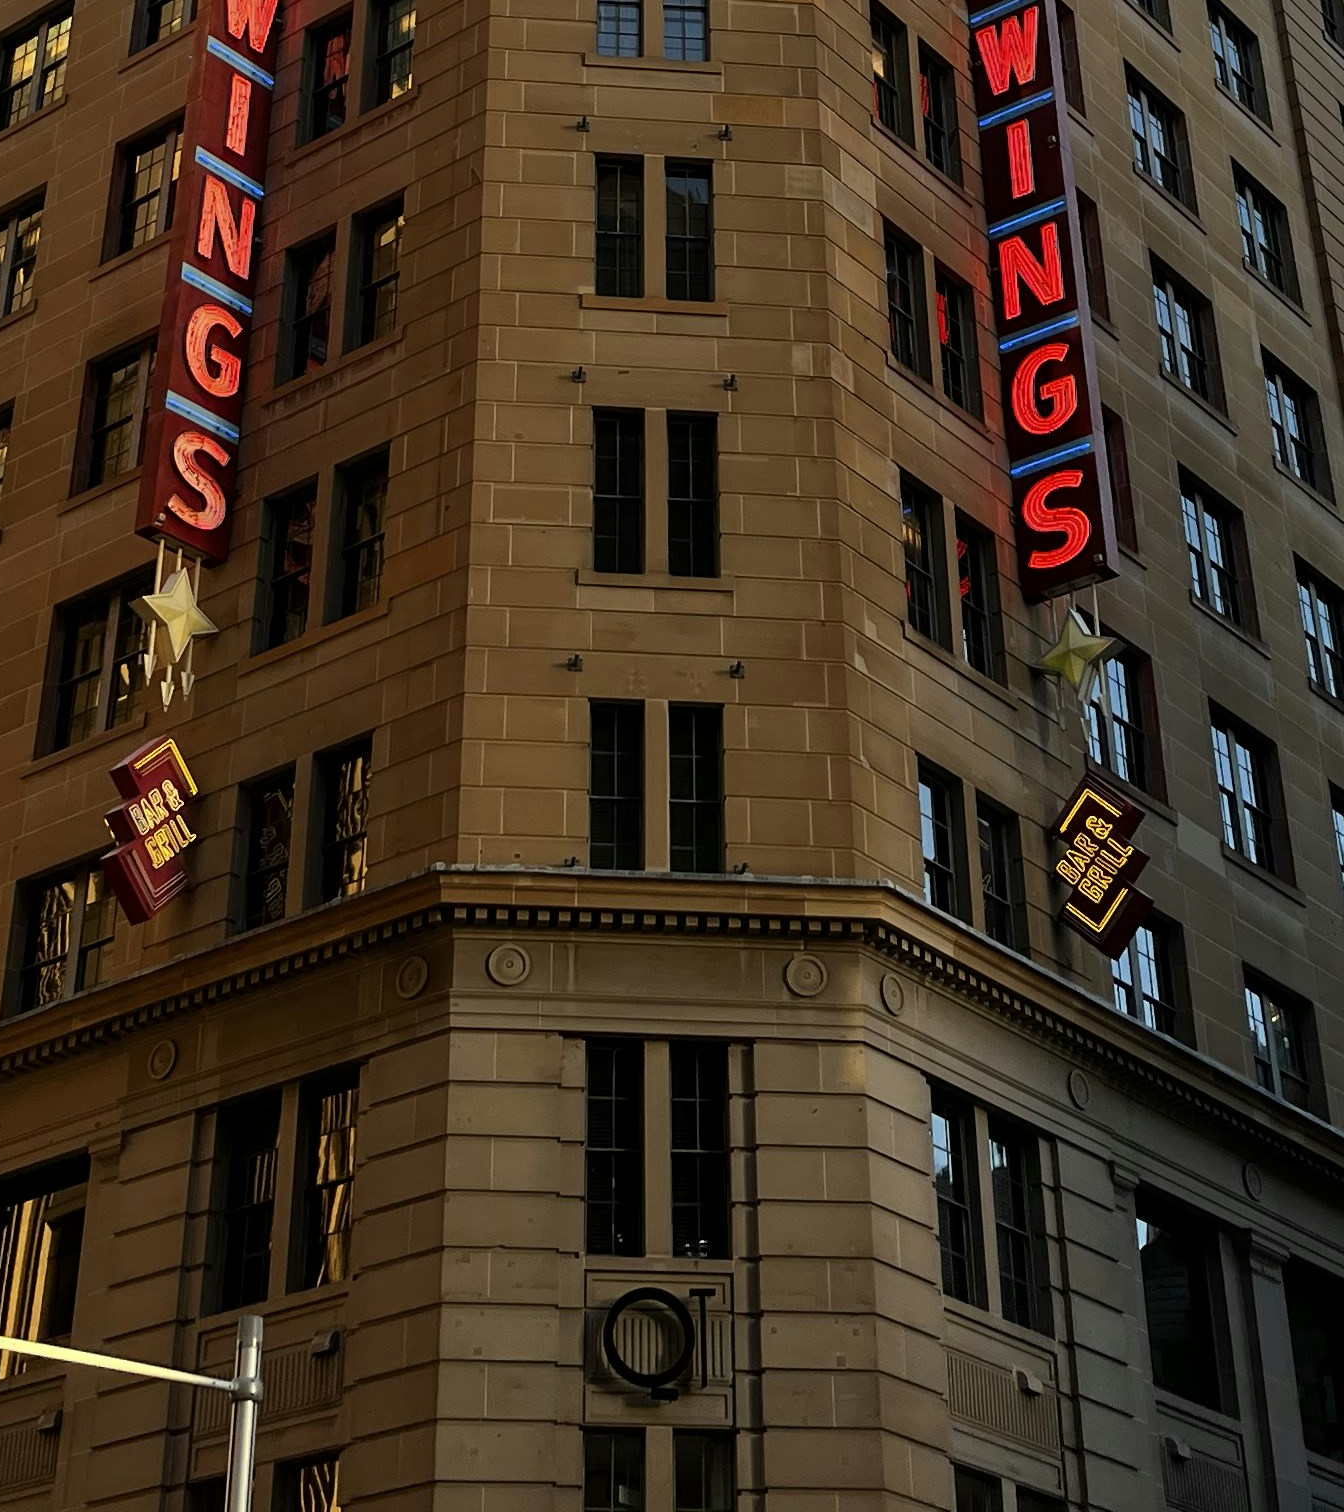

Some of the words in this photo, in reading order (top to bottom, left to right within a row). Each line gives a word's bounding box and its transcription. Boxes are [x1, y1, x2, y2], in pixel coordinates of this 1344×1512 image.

[128, 788, 169, 836] BAR
[161, 779, 185, 811] &
[144, 814, 197, 869] GRILL
[1056, 832, 1099, 885] BAR
[1086, 815, 1113, 840] &
[1077, 838, 1135, 904] GRILL
[603, 1287, 716, 1401] QT
